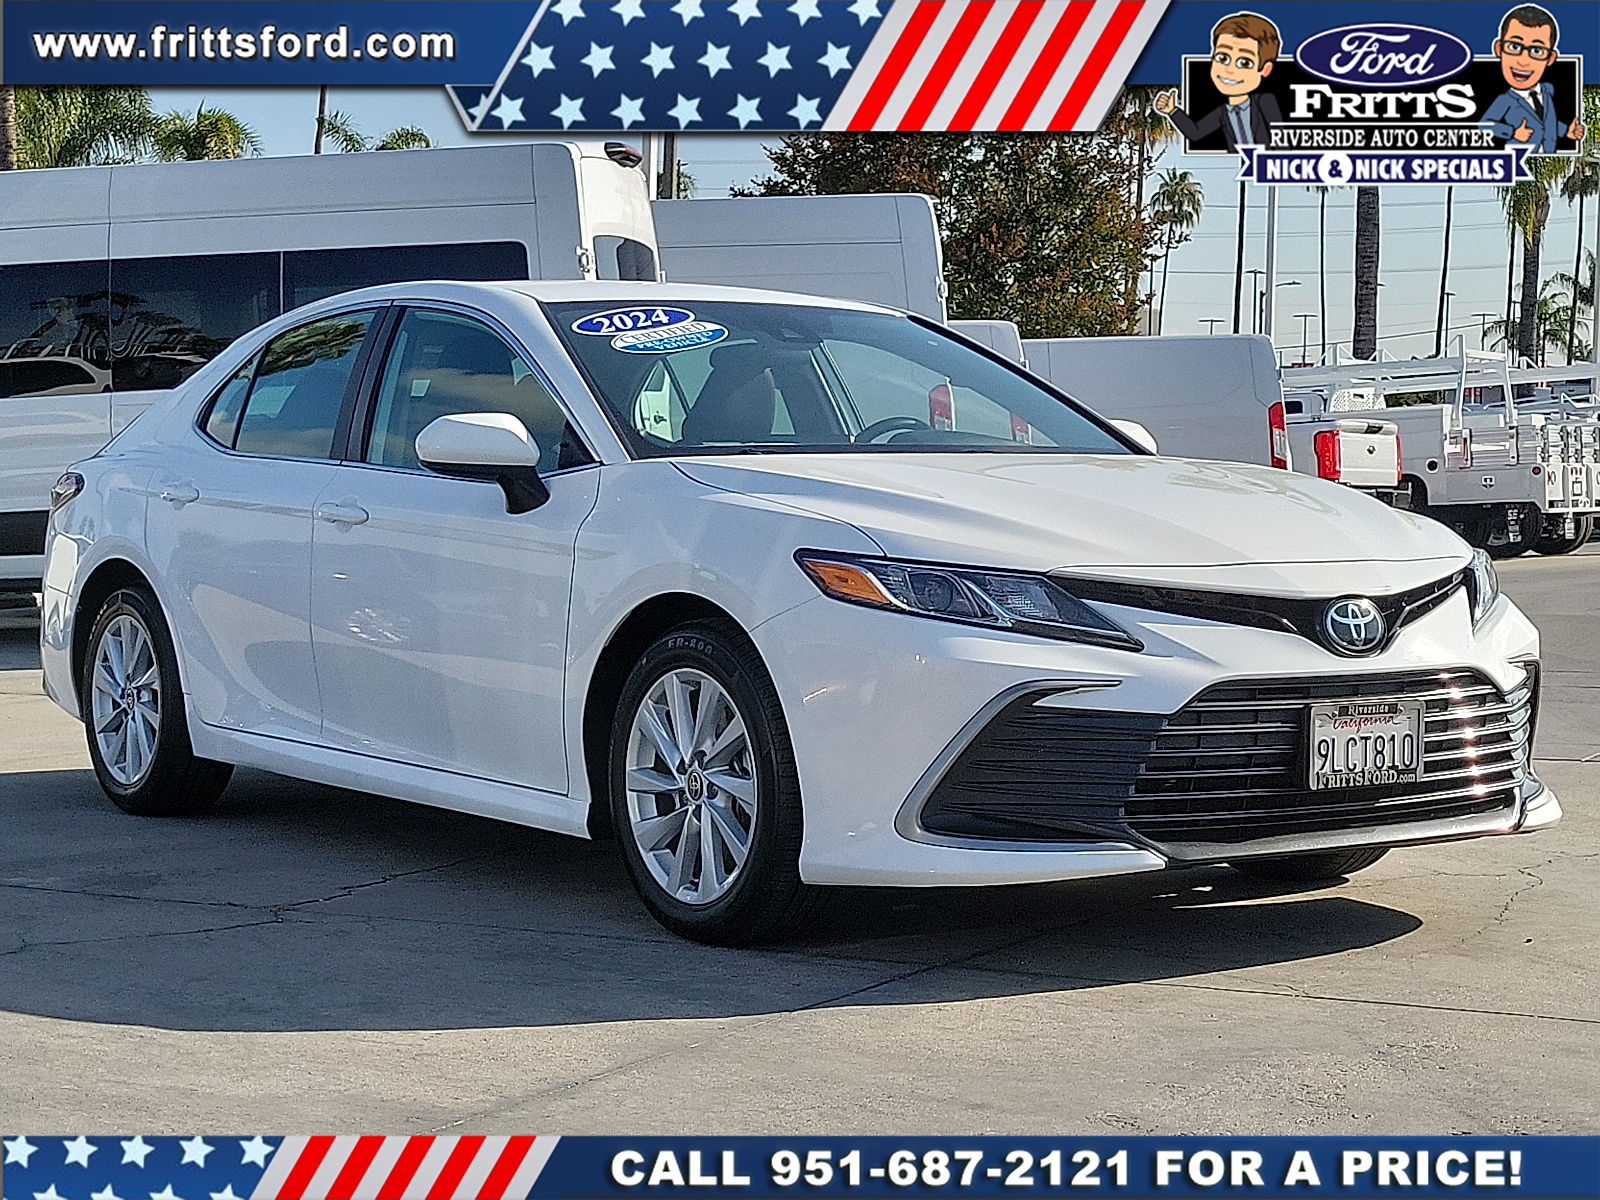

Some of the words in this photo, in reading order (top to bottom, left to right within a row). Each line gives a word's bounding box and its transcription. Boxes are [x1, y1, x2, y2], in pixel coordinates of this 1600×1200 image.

[592, 308, 670, 333] 2024
[619, 322, 707, 344] CERTIFIED
[1347, 704, 1390, 715] Riverside
[1332, 715, 1402, 733] California
[1317, 732, 1415, 773] 9LCT810
